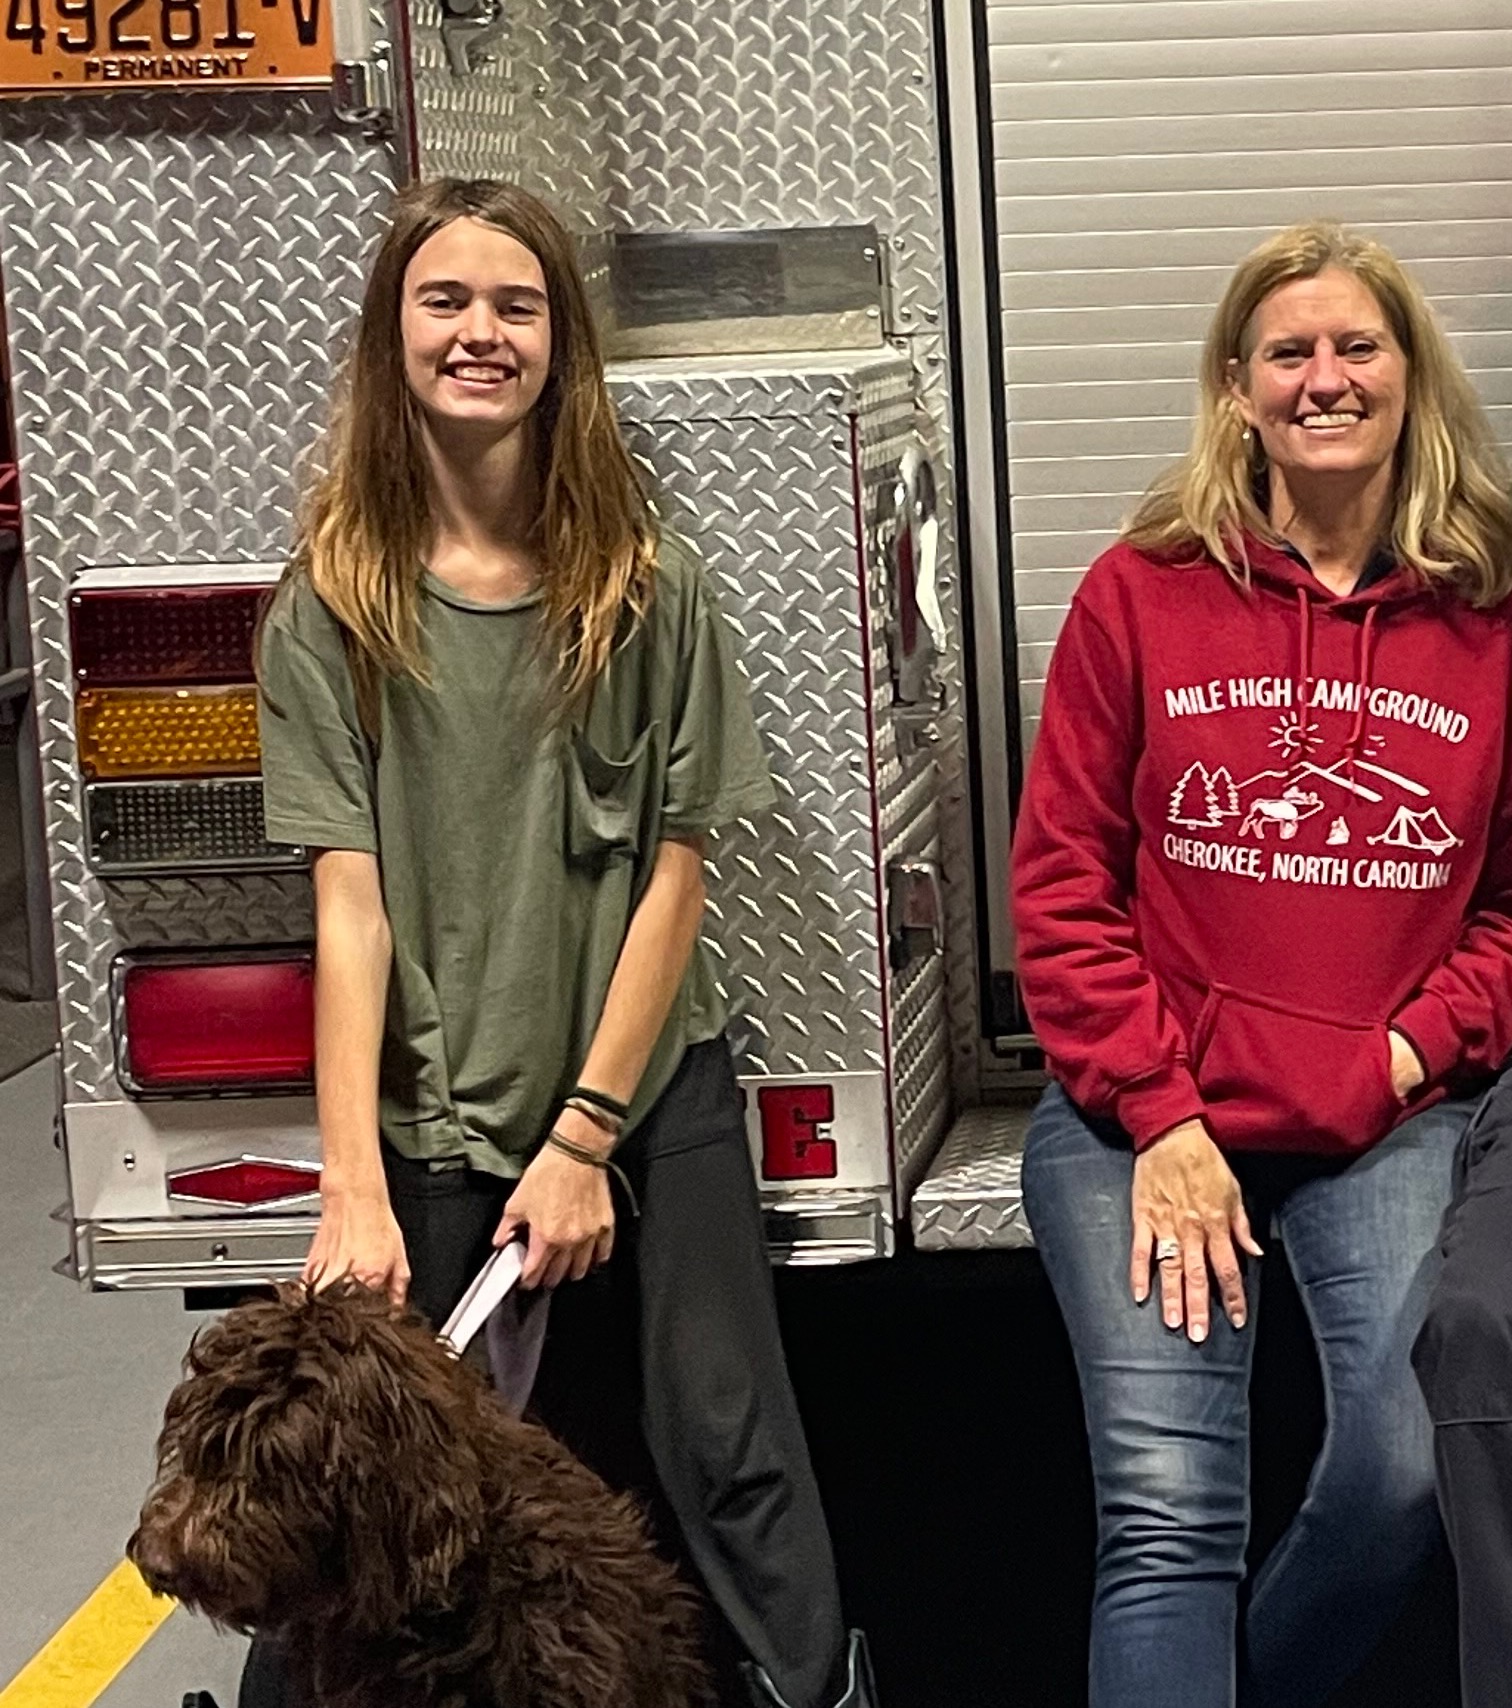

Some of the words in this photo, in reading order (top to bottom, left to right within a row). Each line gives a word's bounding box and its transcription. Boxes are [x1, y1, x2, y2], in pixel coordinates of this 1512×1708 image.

[84, 54, 249, 80] PERMANENT
[1164, 680, 1226, 719] MILE
[1228, 676, 1292, 709] HIGH
[1297, 677, 1471, 744] CAMPGROUND
[1163, 832, 1267, 884] CHEROKEE,
[1272, 852, 1349, 887] NORTH
